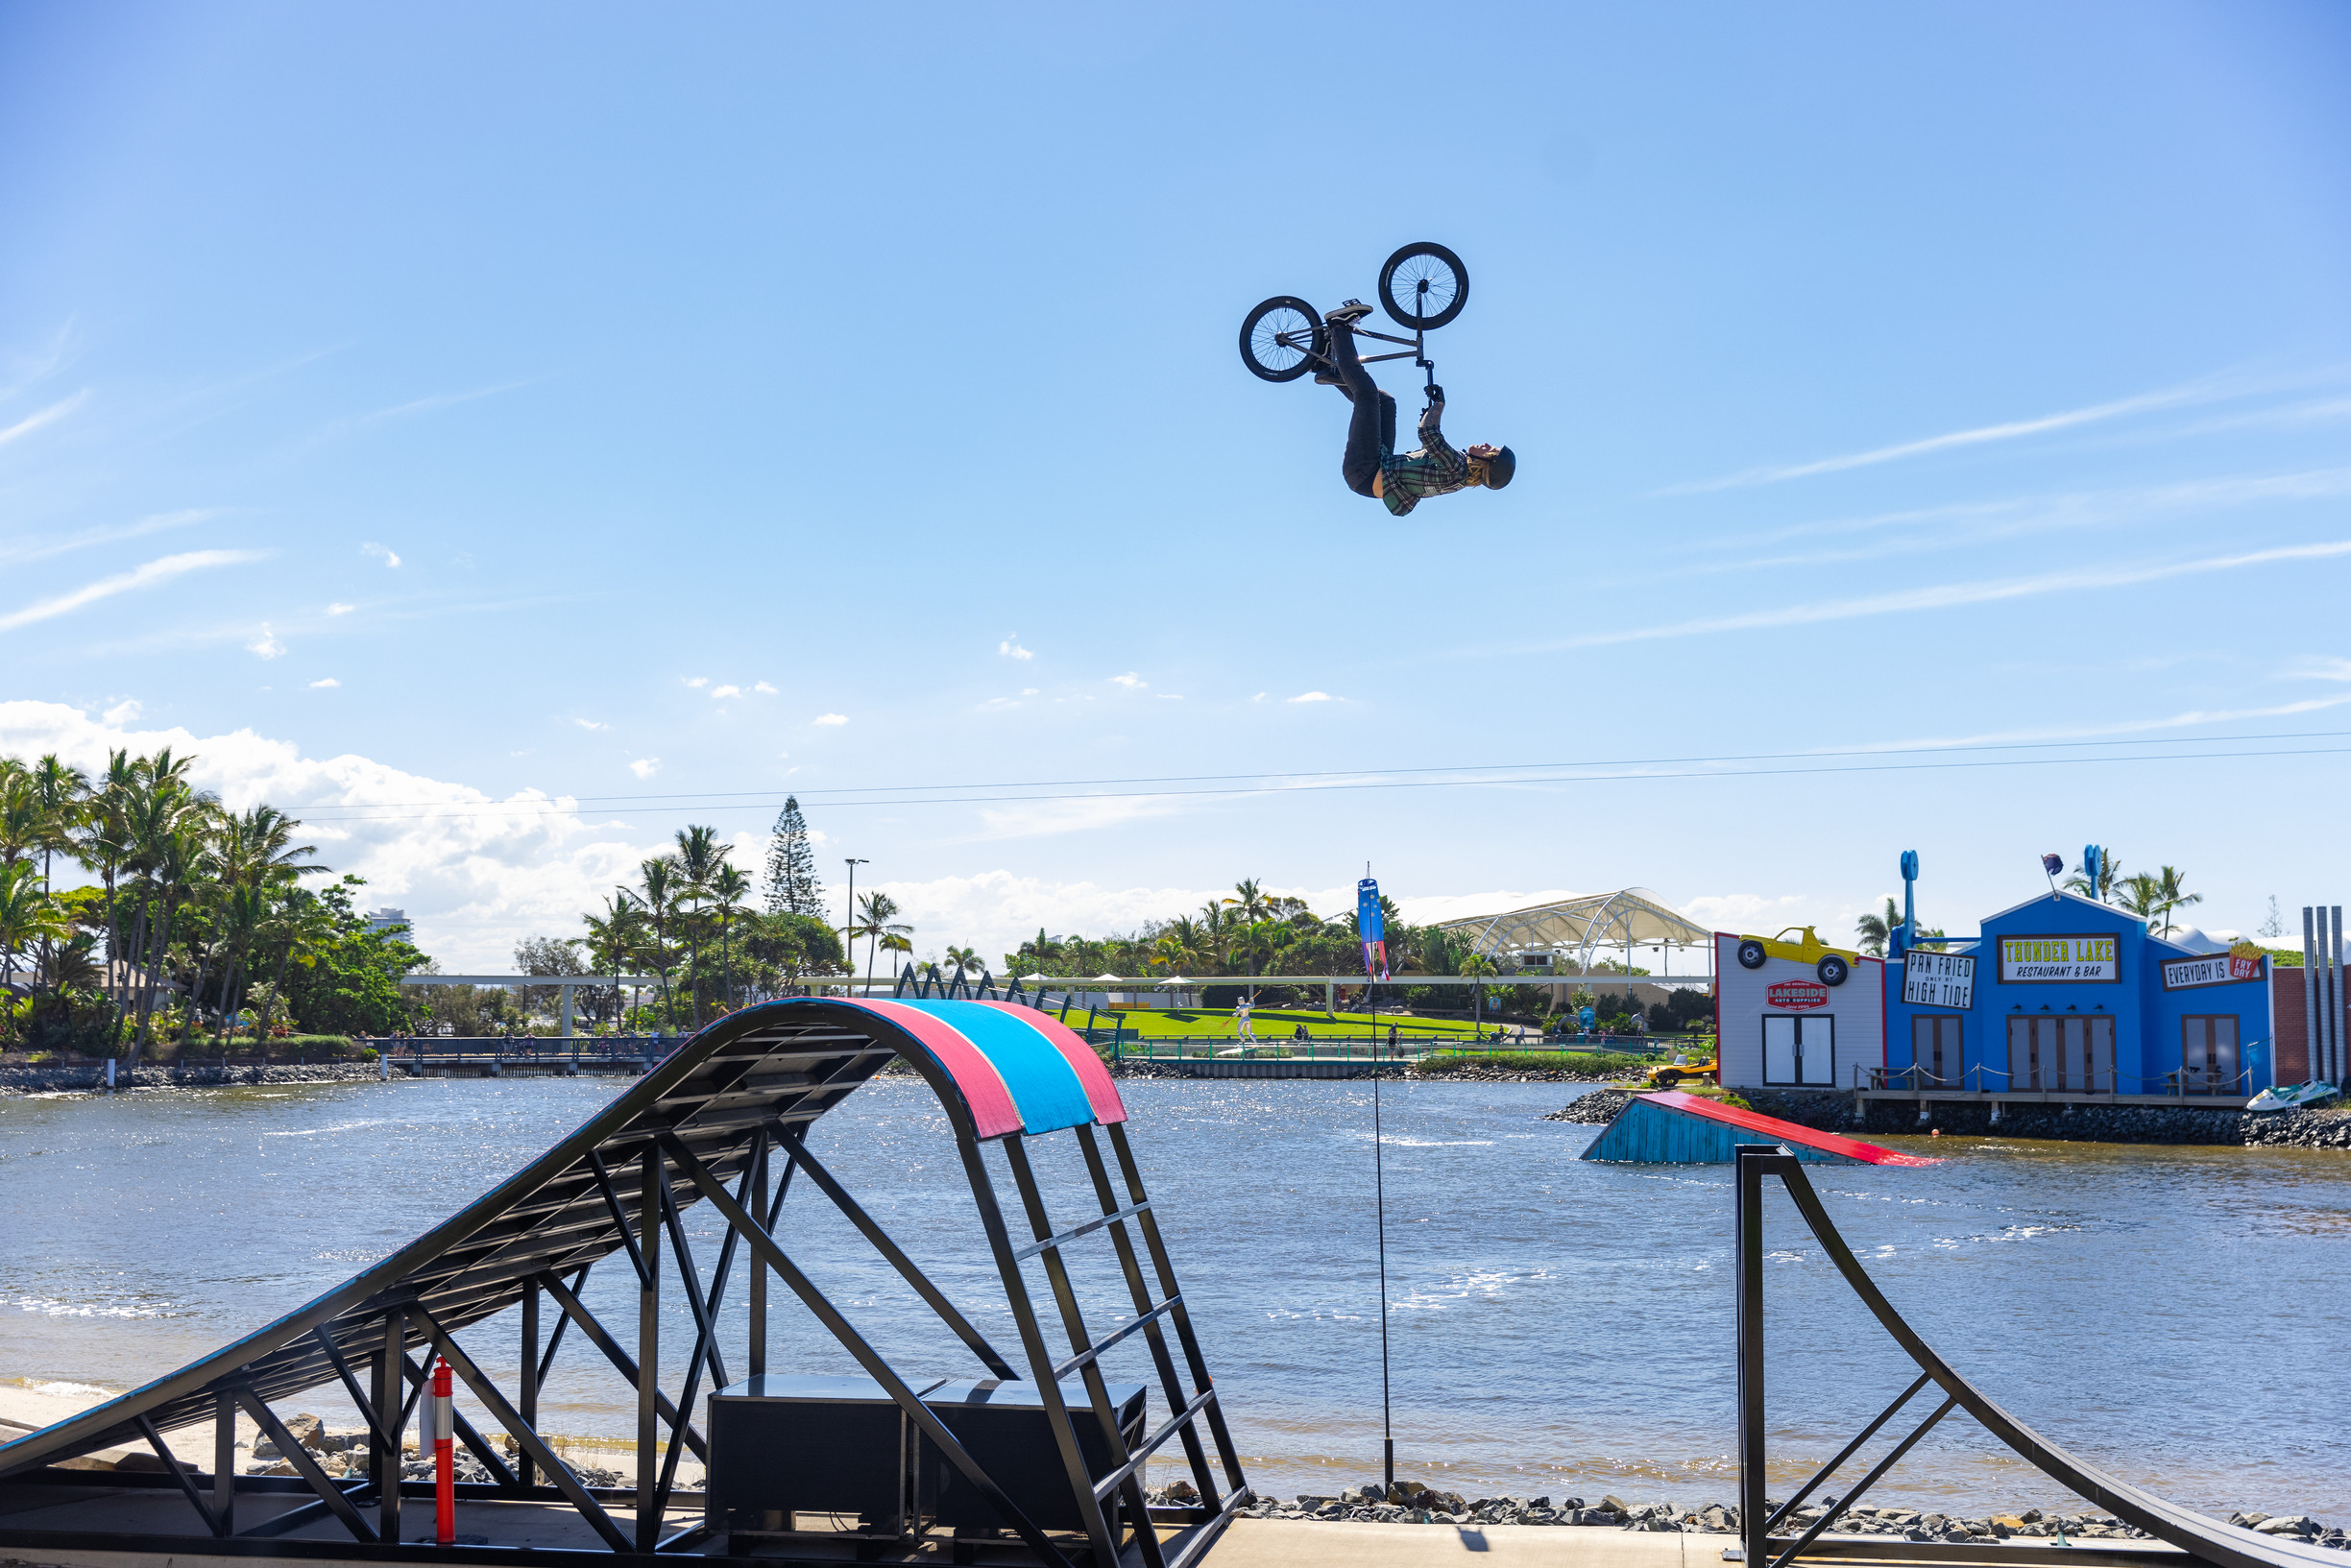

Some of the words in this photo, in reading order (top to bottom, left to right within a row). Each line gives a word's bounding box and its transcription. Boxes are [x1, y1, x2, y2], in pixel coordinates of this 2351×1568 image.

[2004, 941, 2069, 962] THUNDER
[2076, 940, 2113, 961] LAKE
[1910, 953, 1932, 974] PAN
[1938, 956, 1971, 977] FRIED
[2016, 966, 2072, 977] RESTAURANT
[2074, 966, 2081, 977] &
[2083, 966, 2102, 977] BAR
[2168, 963, 2212, 984] EVERYDAY
[2215, 961, 2225, 979] IS
[2235, 958, 2252, 970] FRY
[2233, 968, 2251, 978] DAY
[1769, 988, 1826, 997] LAKESIDE
[1907, 980, 1936, 1003] HIGH
[1943, 984, 1969, 1007] TIDE
